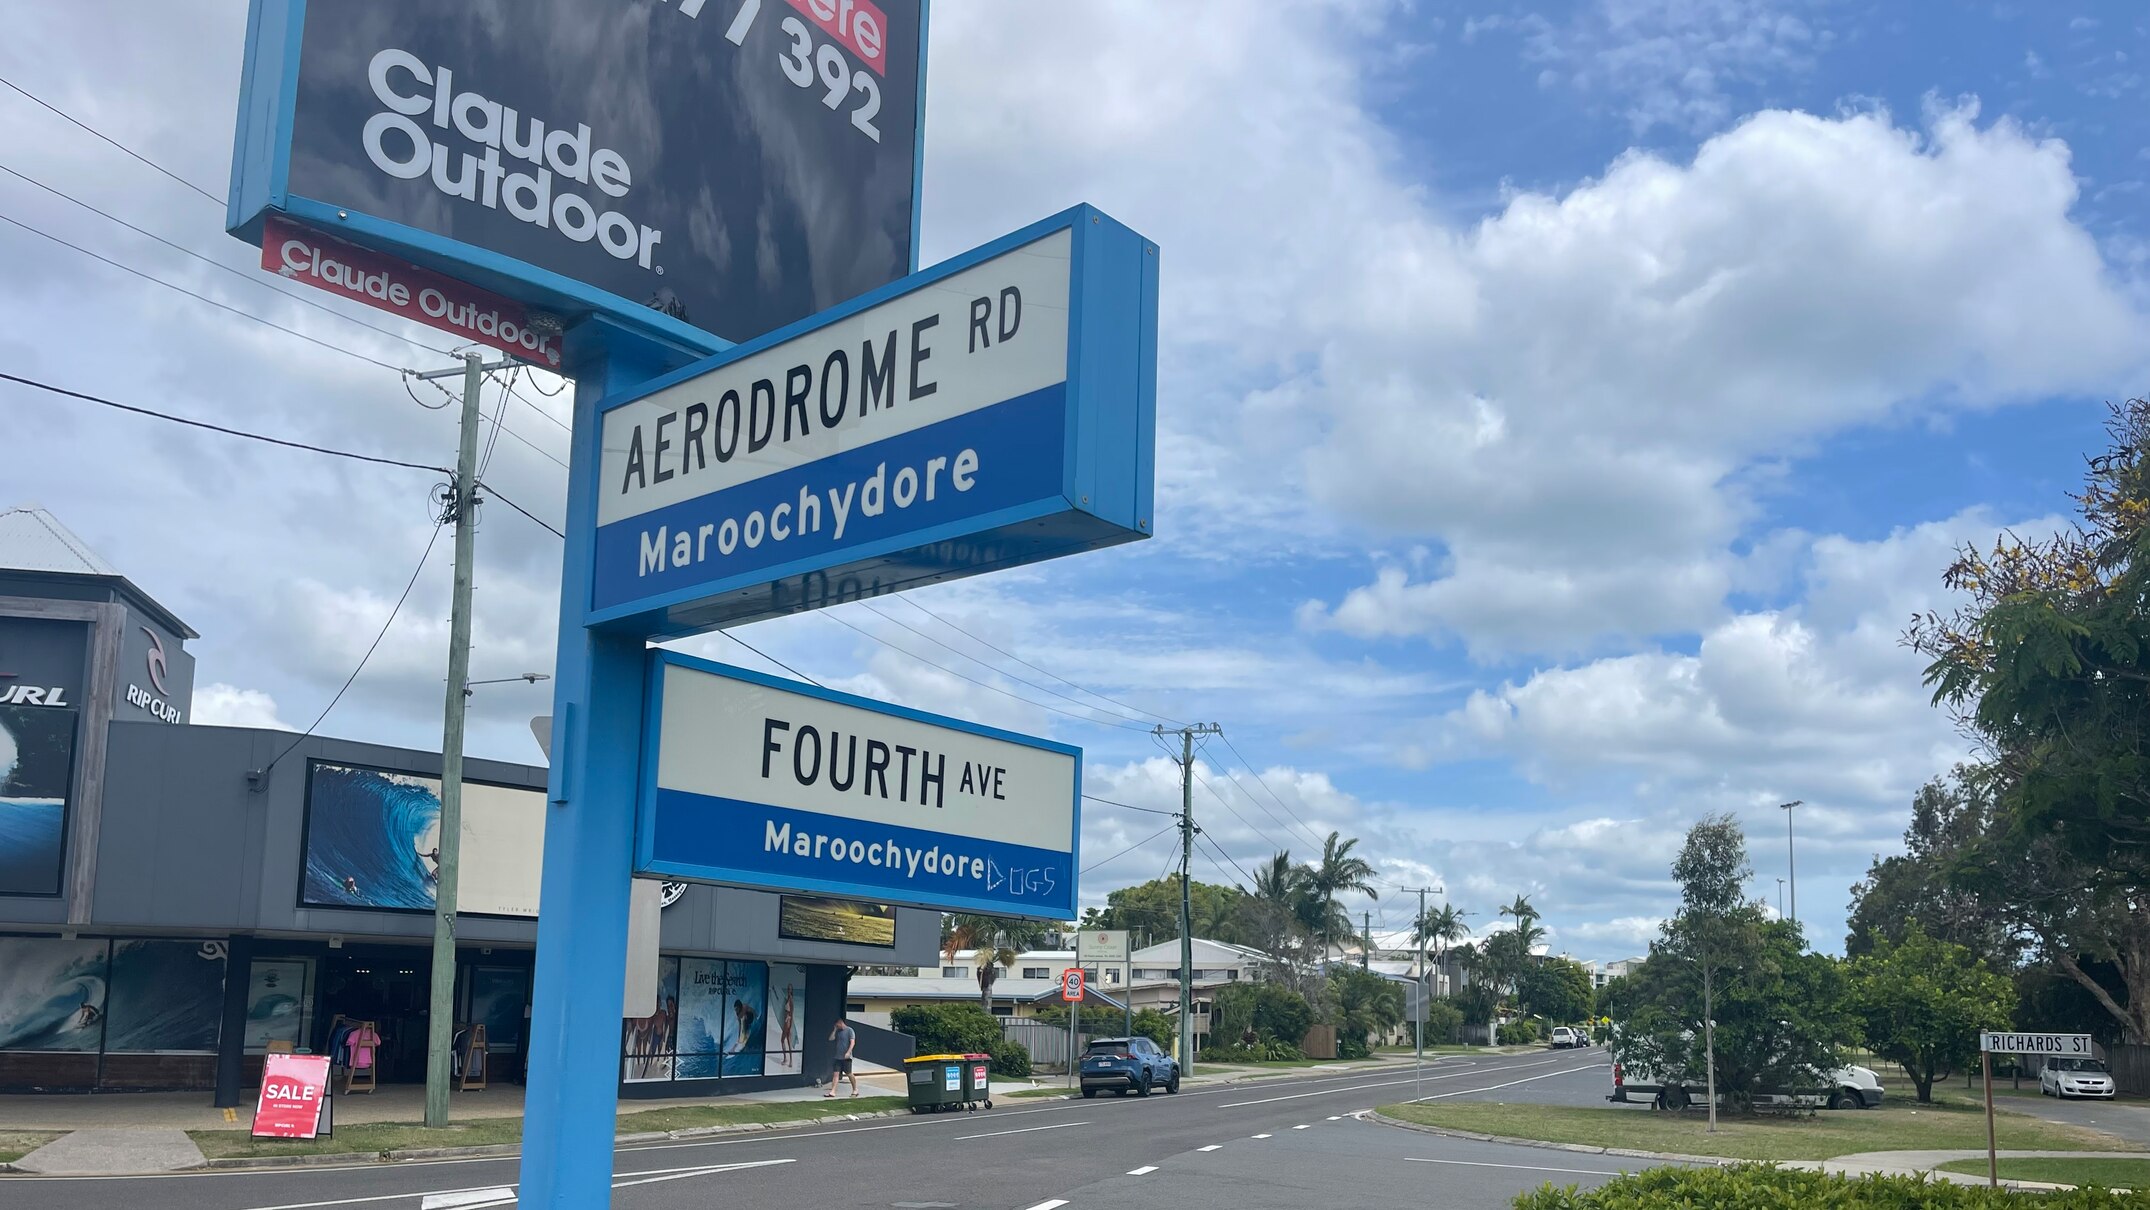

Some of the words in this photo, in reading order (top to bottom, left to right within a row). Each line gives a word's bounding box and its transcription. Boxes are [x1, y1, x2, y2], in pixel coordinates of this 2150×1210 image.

[368, 48, 632, 199] Claude
[778, 16, 882, 145] 392
[362, 112, 662, 271] Outdoor
[280, 240, 411, 307] Claude
[418, 288, 551, 354] Outdoor
[622, 313, 940, 495] AERODROME
[968, 285, 1022, 354] RD
[638, 448, 979, 577] Maroochydore
[127, 683, 151, 710] RIP
[762, 717, 945, 809] FOURTH
[960, 761, 1006, 801] AVE
[764, 820, 985, 880] Maroochydore
[1069, 978, 1079, 986] 40
[266, 1084, 315, 1101] SALE
[1993, 1036, 2062, 1051] RICHARDS
[2073, 1038, 2088, 1052] ST
